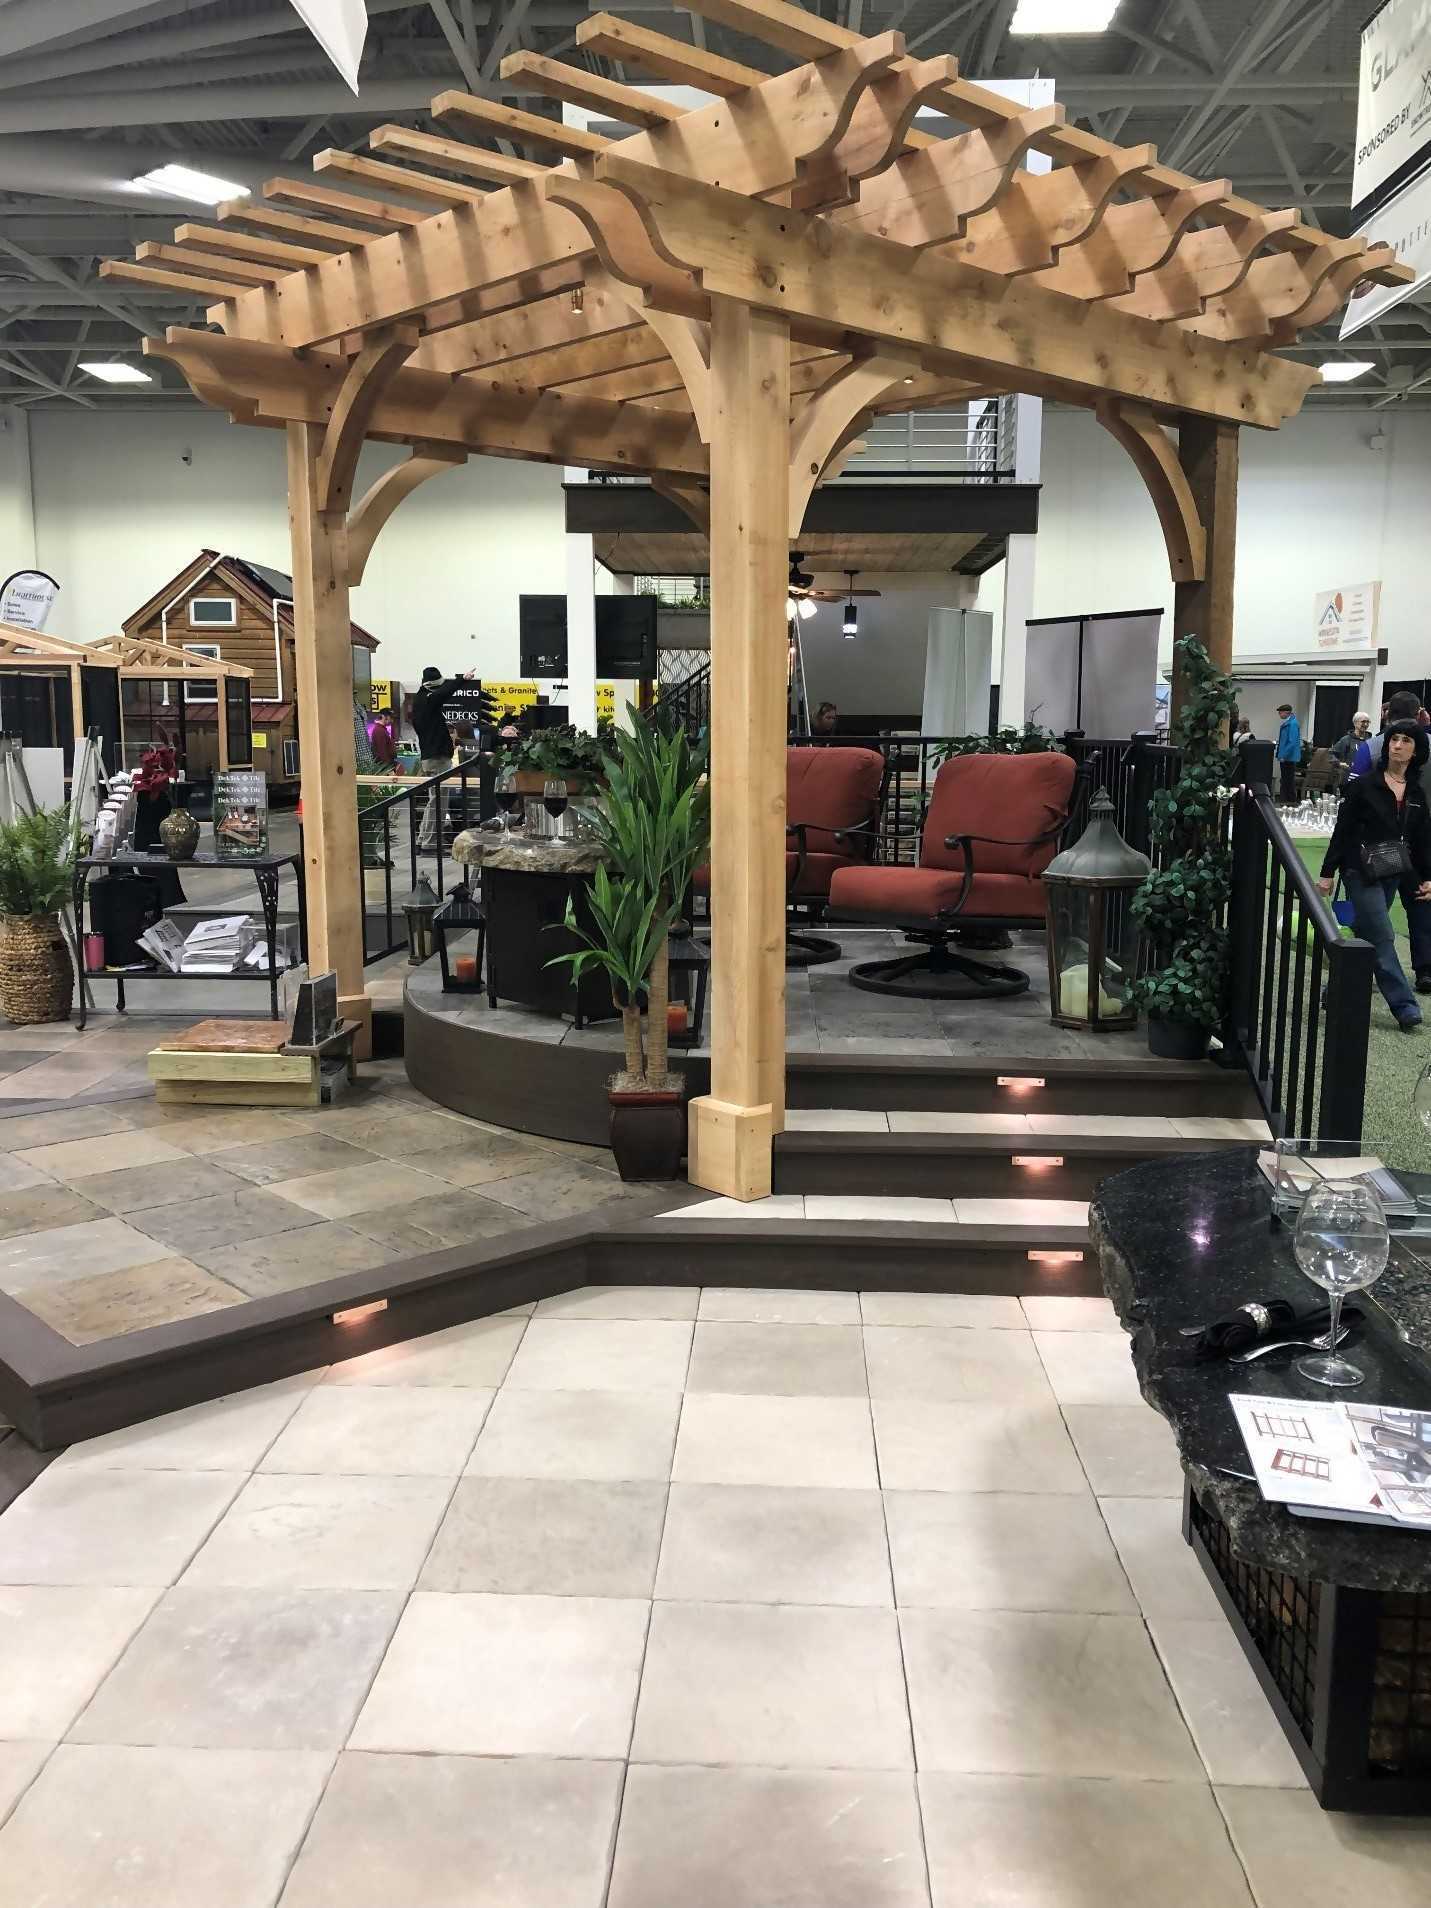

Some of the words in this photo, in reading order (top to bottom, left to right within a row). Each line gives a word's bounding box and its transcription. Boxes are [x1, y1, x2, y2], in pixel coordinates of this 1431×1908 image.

[1358, 114, 1400, 165] SPONSORED
[1401, 102, 1411, 125] BY
[500, 686, 506, 694] &
[508, 687, 537, 695] Granite
[441, 711, 479, 721] NEDECKS
